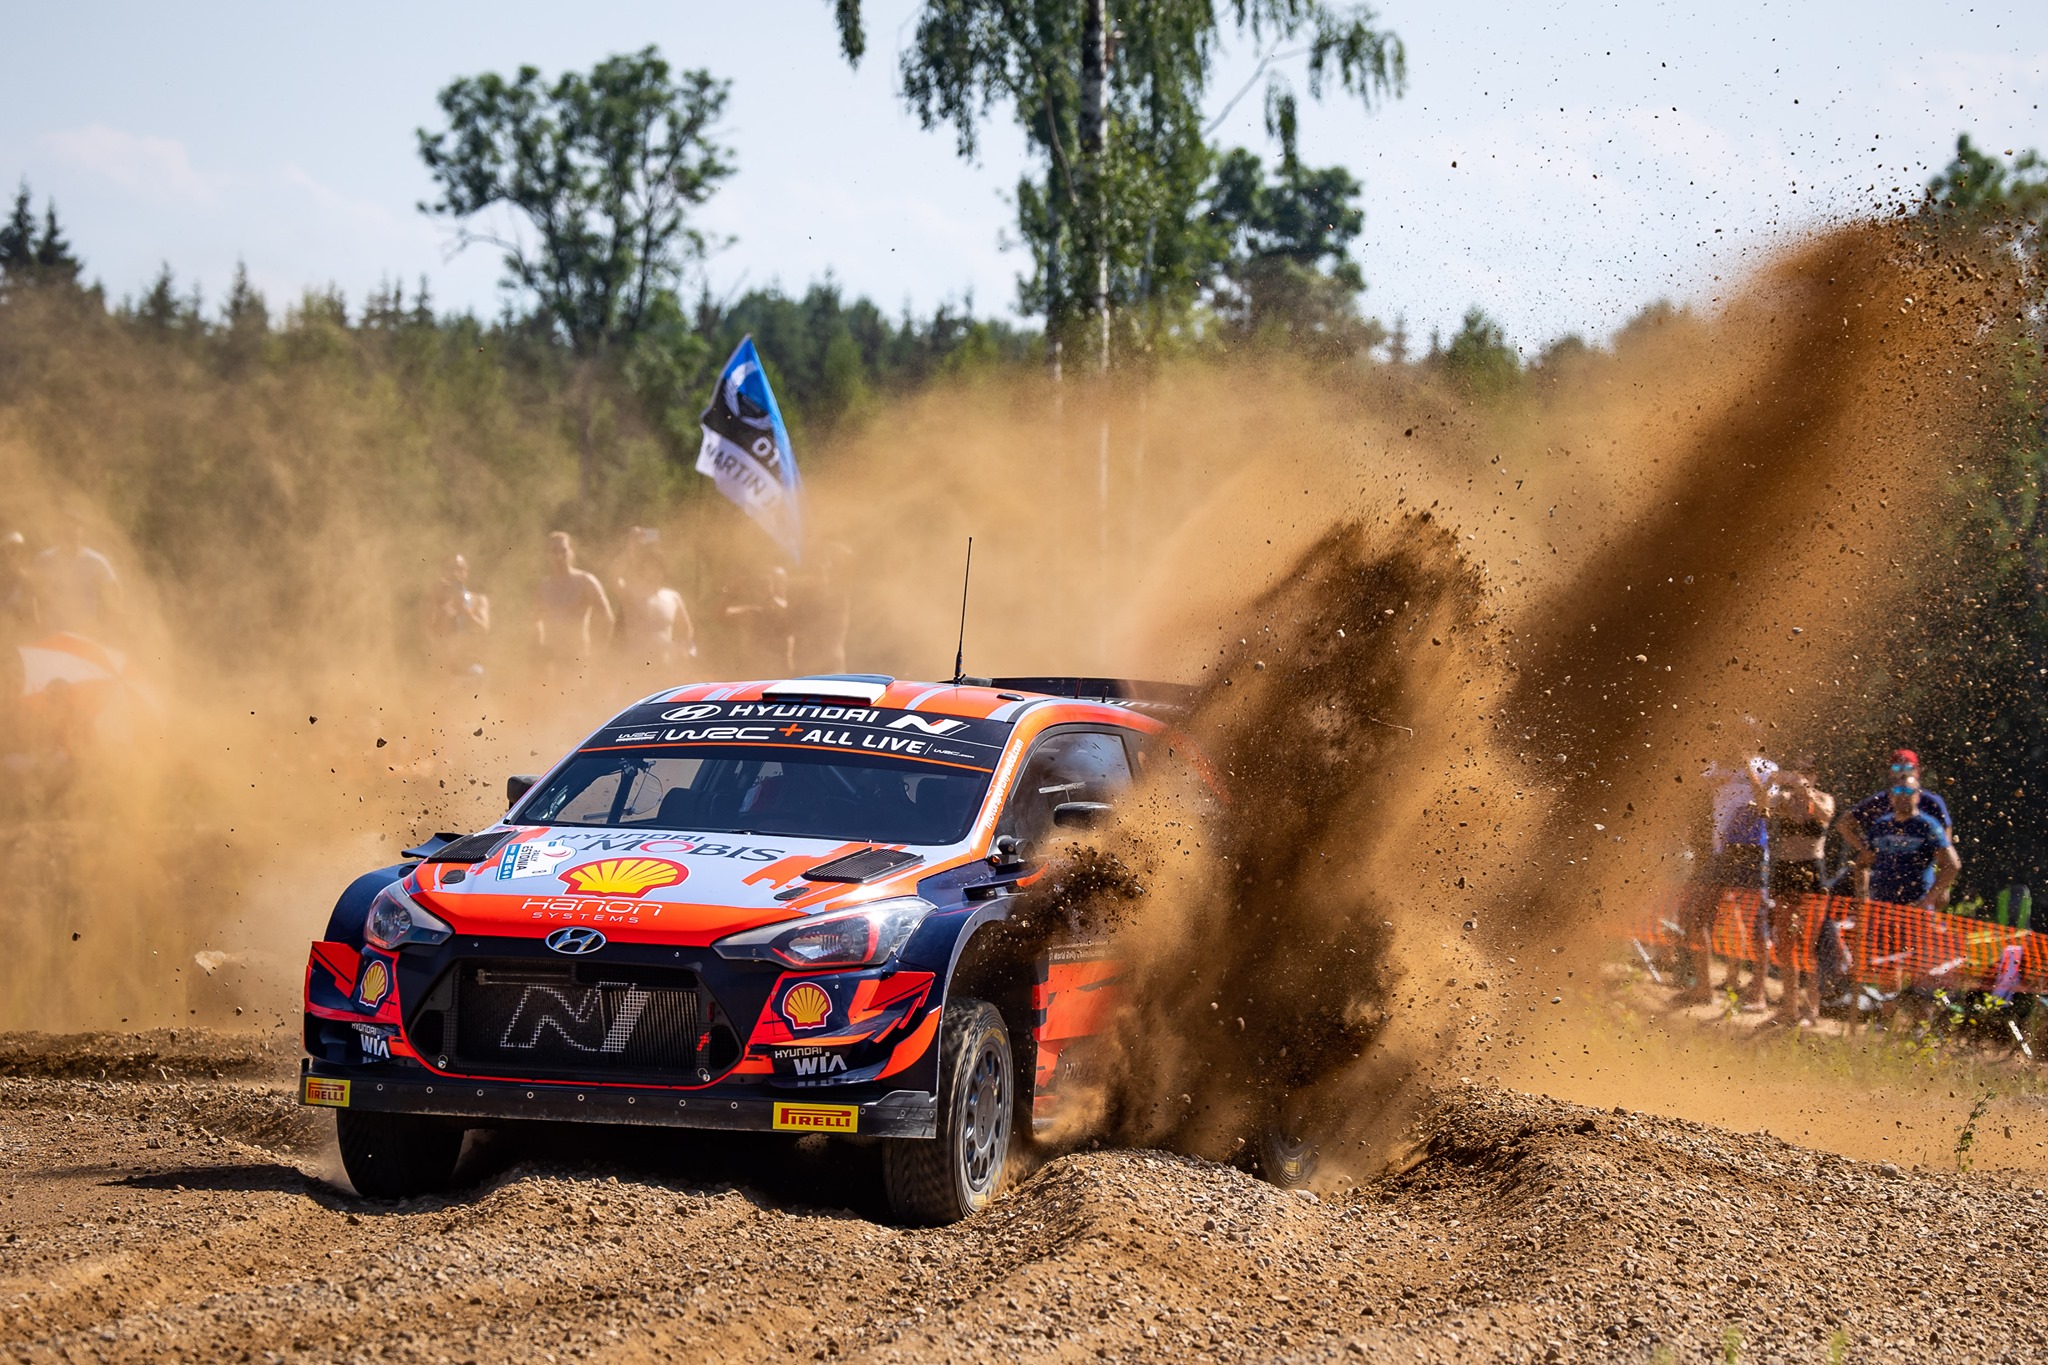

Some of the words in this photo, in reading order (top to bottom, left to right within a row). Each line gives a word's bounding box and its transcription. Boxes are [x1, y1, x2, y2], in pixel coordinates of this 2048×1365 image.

[728, 704, 880, 723] HYUNDAI
[801, 729, 853, 745] ALL
[862, 734, 927, 755] LIVE
[555, 833, 705, 843] HYUNDAI
[516, 845, 534, 872] ESTONIA
[578, 839, 786, 862] MOBIS
[532, 912, 639, 924] SYSTEMS
[351, 1022, 377, 1036] HYUNDAI
[774, 1046, 823, 1059] HYUNDAI
[307, 1081, 345, 1102] PIRELLI
[780, 1107, 852, 1128] PIRELLI
